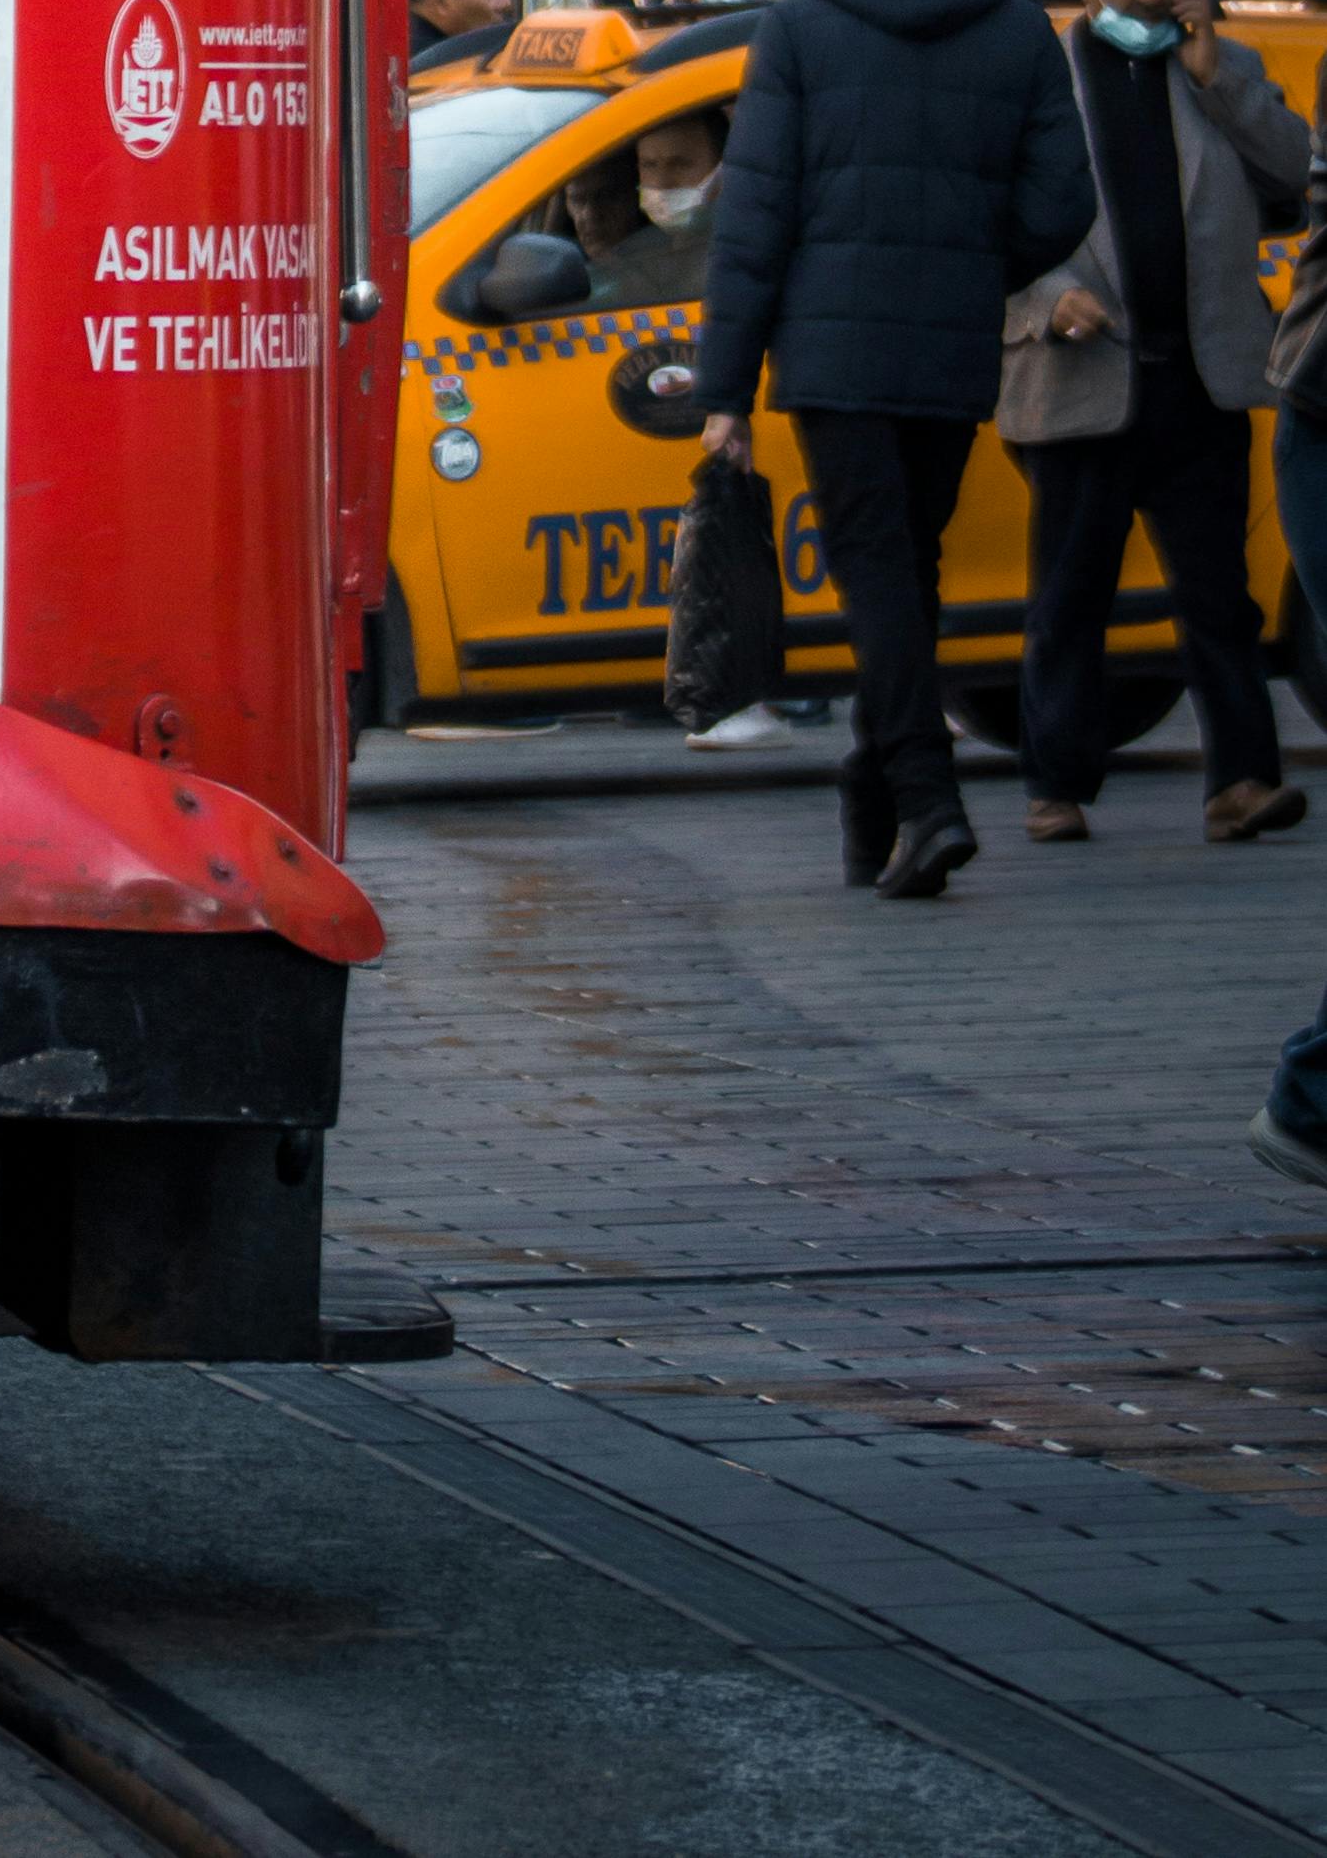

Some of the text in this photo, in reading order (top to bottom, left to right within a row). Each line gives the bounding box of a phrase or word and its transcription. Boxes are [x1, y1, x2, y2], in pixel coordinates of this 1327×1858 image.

[198, 81, 308, 126] ALO 153
[95, 225, 258, 282] ASILMAK
[84, 315, 137, 372] VE
